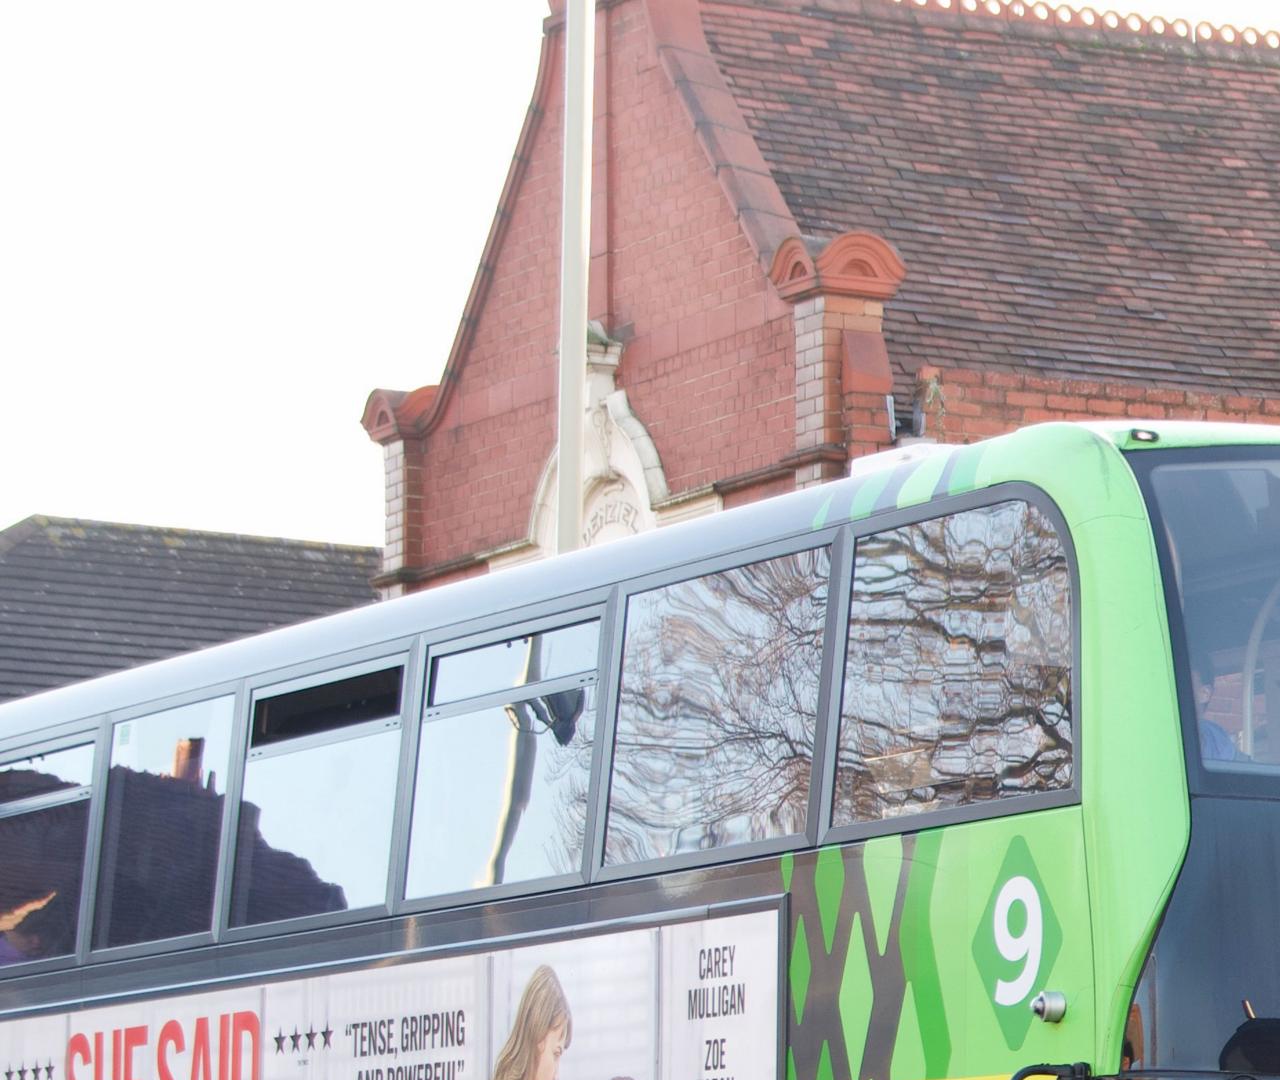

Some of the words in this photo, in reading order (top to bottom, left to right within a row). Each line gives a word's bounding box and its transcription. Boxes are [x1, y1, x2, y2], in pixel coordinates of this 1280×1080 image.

[993, 875, 1044, 1006] 9
[698, 944, 736, 981] CAREY
[688, 983, 746, 1021] MULLIGAN
[401, 1009, 466, 1053] GRIPPING
[704, 1038, 727, 1071] ZOE
